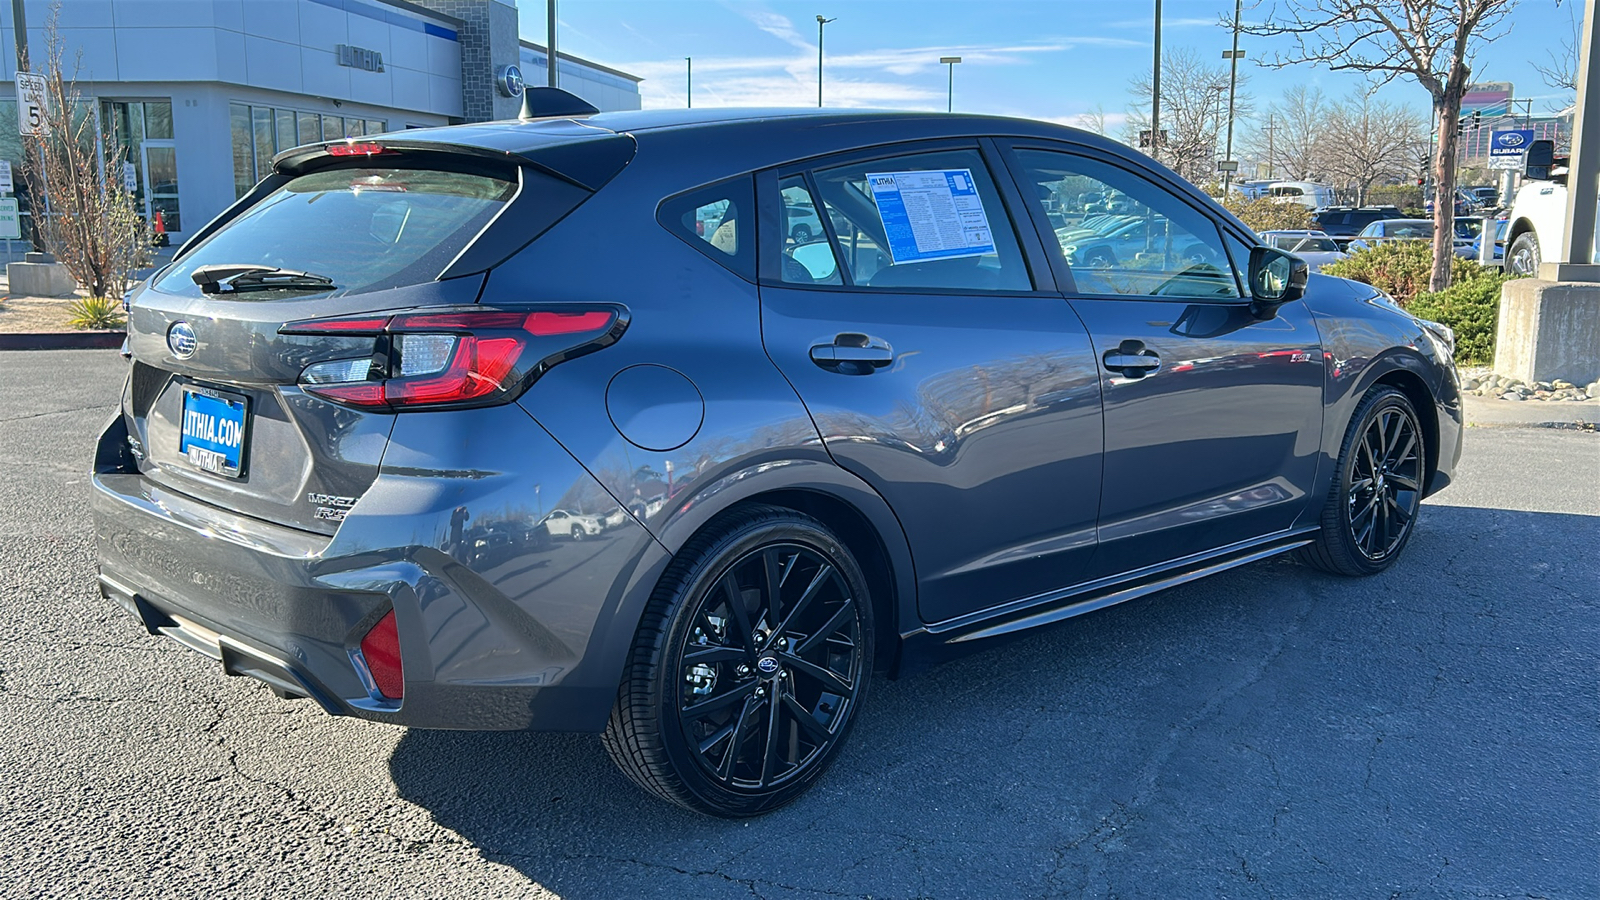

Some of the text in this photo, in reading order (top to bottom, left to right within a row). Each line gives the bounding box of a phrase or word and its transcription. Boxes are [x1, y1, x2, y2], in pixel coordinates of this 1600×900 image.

[336, 44, 385, 73] LITHIA
[20, 79, 44, 91] SPEED
[29, 106, 41, 127] 5
[183, 409, 243, 448] LITHIA.COM
